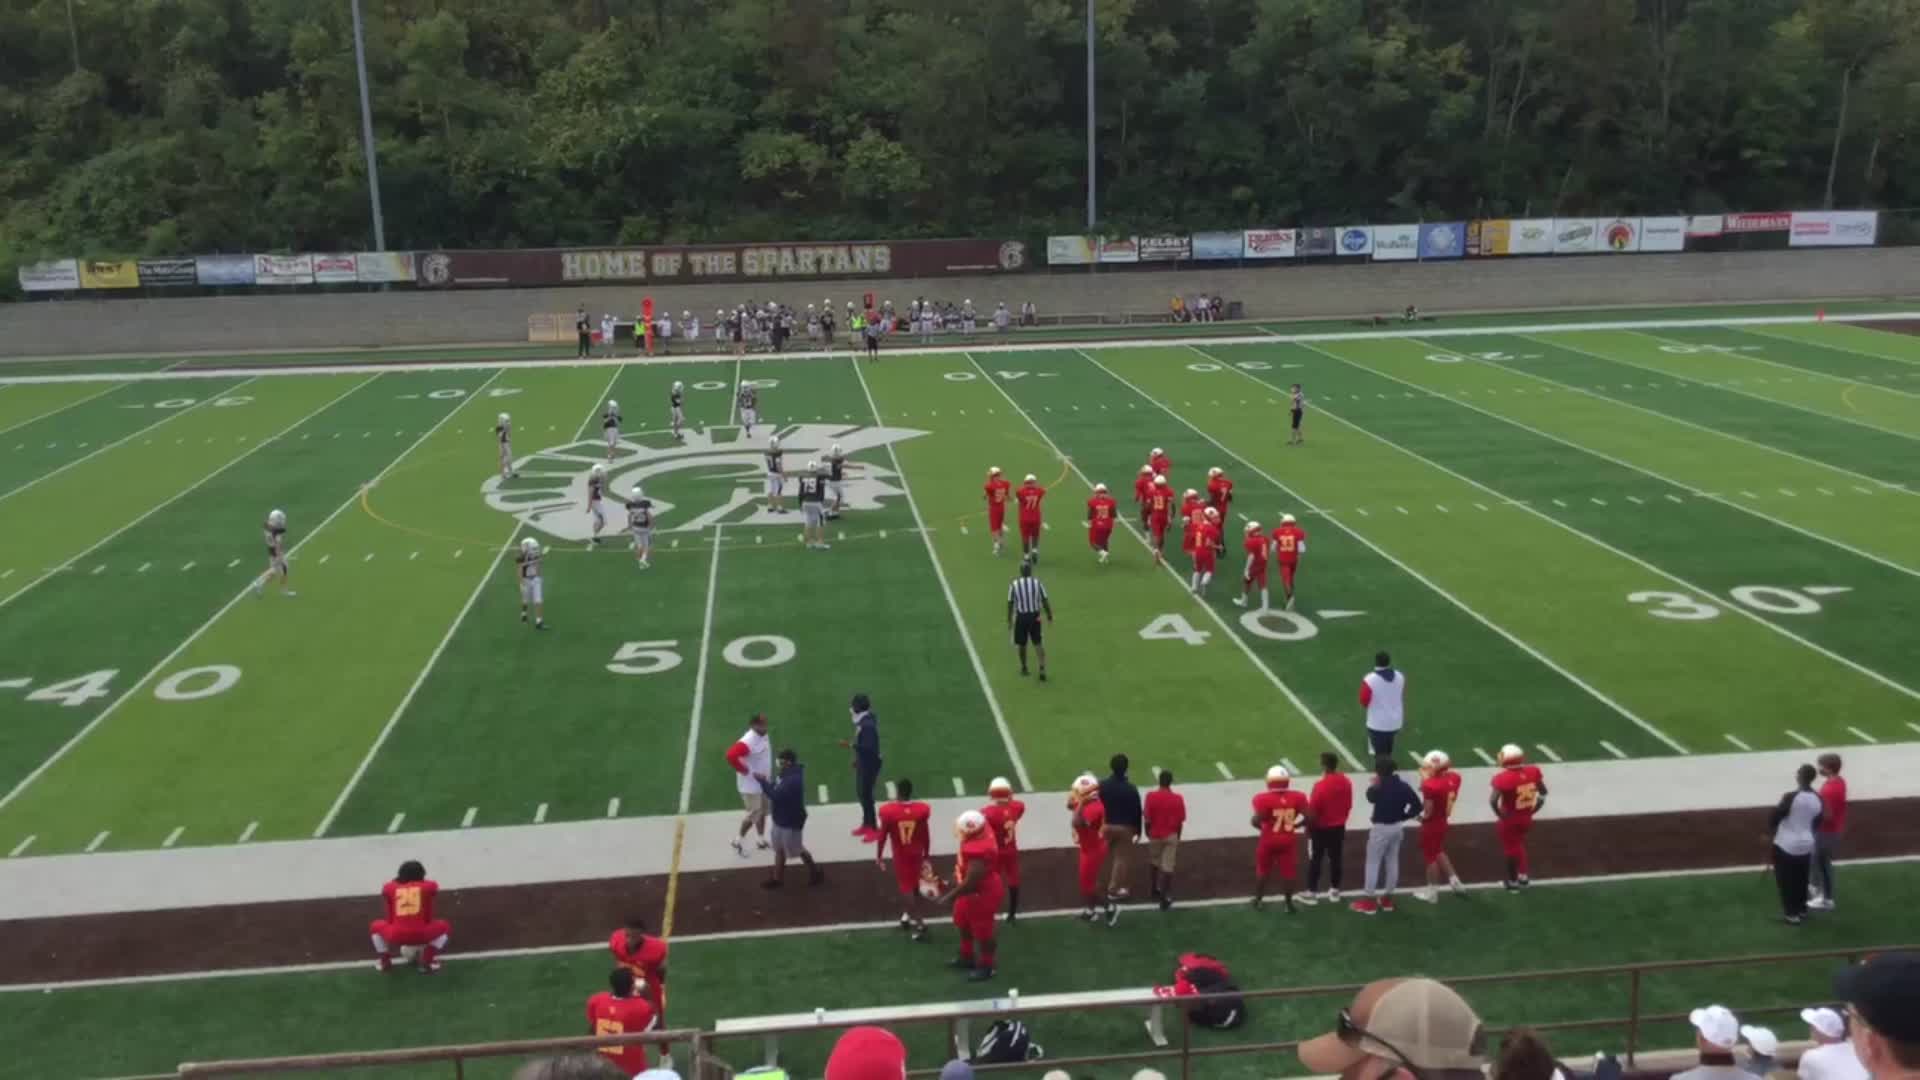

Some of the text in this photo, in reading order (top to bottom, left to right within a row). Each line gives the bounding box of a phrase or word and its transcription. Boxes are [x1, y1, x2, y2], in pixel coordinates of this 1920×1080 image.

[1140, 237, 1190, 247] KELSEY
[561, 245, 891, 280] HOME OF THE SPARTANS
[943, 371, 1029, 382] 40
[1627, 585, 1822, 619] 30
[1139, 612, 1319, 646] 40
[605, 634, 796, 674] 50
[25, 664, 243, 706] 40
[1515, 783, 1537, 808] 25
[898, 820, 916, 844] 17
[395, 886, 421, 916] 29
